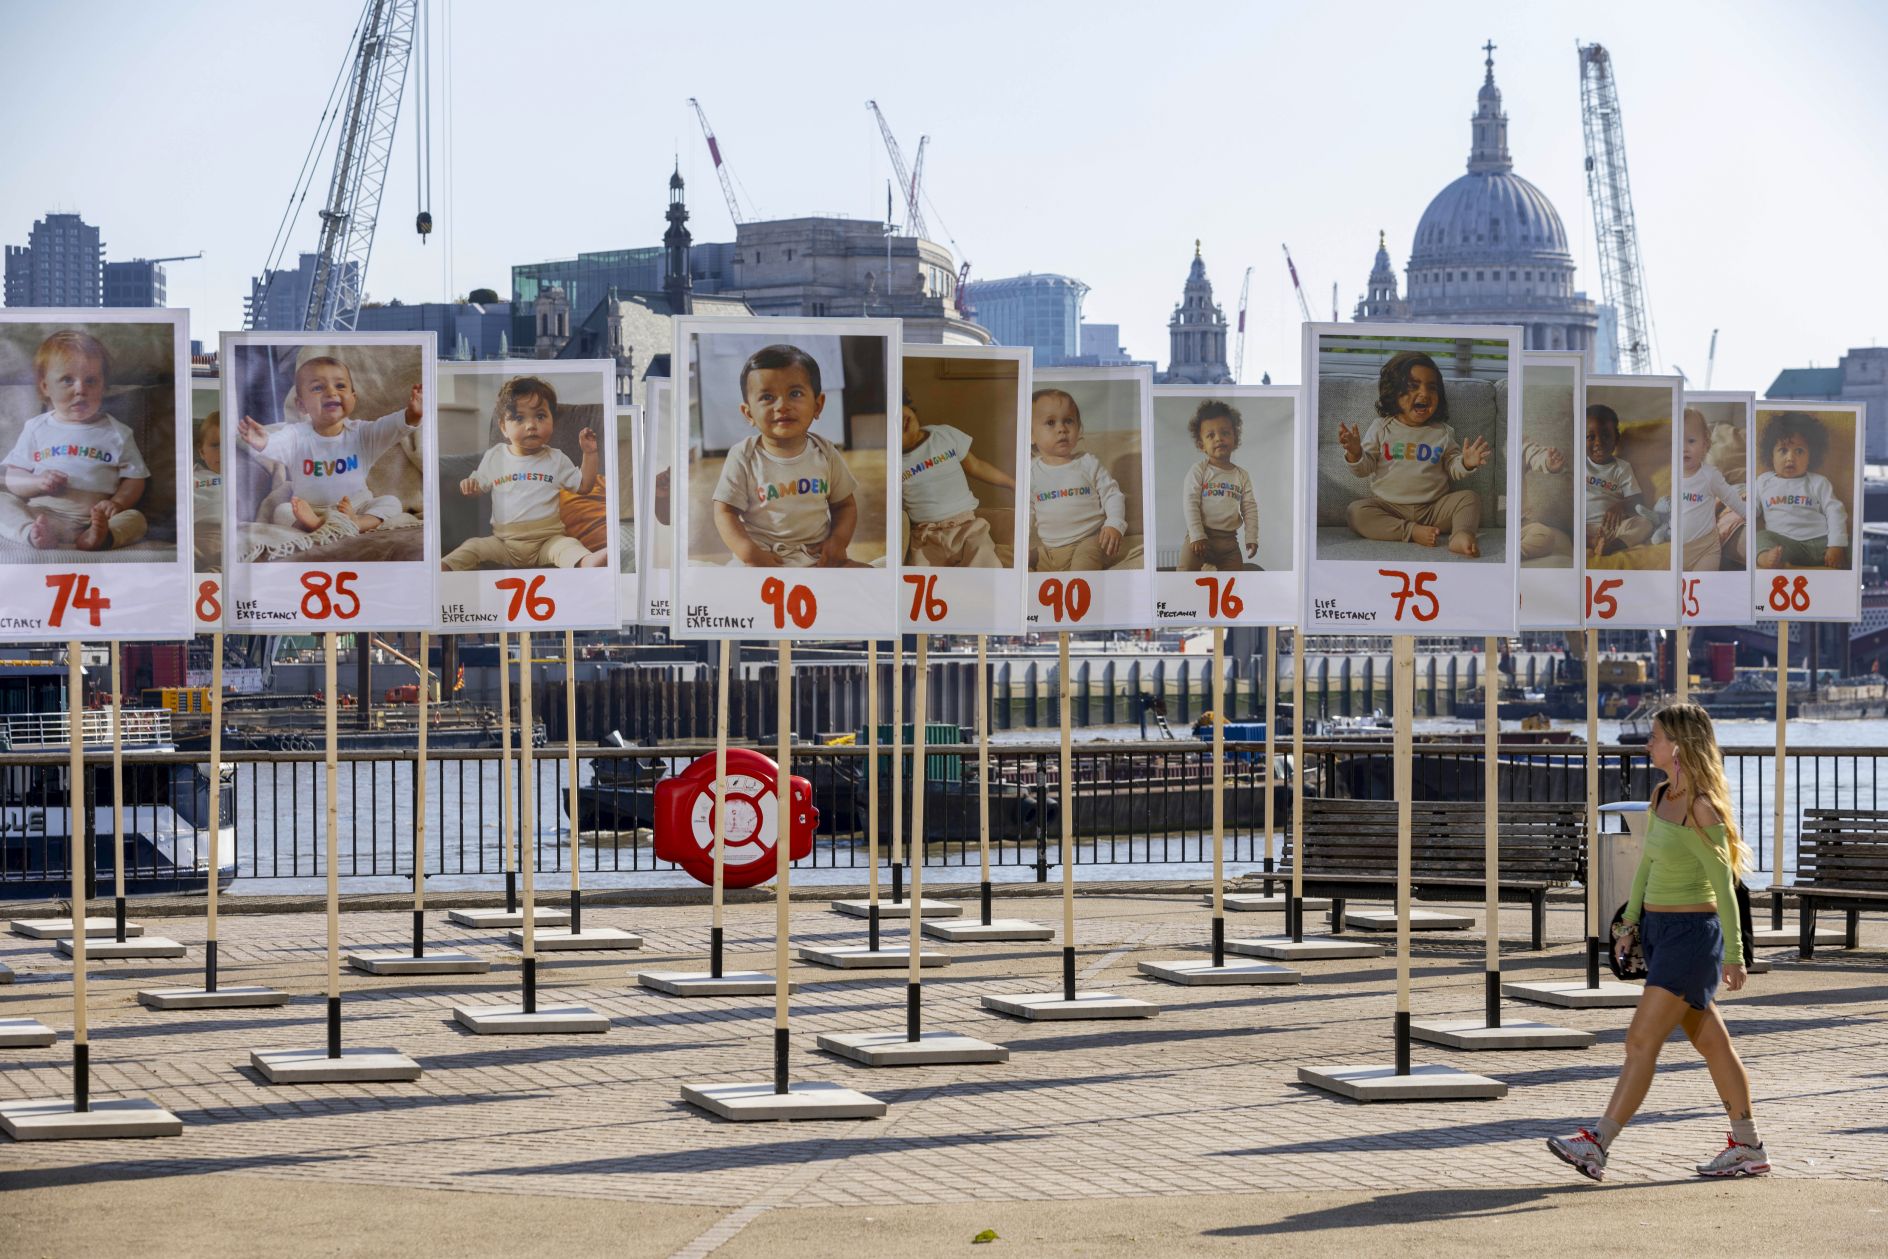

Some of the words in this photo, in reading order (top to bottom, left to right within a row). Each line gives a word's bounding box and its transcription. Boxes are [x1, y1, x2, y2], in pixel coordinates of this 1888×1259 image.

[34, 444, 112, 463] BIRKENHEAD
[1382, 442, 1443, 464] LEEDS
[303, 454, 358, 477] DEVON
[494, 472, 554, 487] MANCHESTER
[756, 478, 828, 502] CAMDEN
[1036, 486, 1091, 502] KENSINGTON
[1765, 495, 1813, 508] LAMBETH
[46, 573, 110, 627] 74
[301, 571, 360, 619] 85
[495, 575, 556, 622] 76
[761, 576, 817, 629] 90
[903, 575, 948, 622] 76
[1038, 578, 1091, 622] 90
[1196, 577, 1243, 618] 76
[1379, 570, 1439, 621] 75
[1769, 576, 1810, 611] 88
[237, 600, 257, 609] LIFE
[237, 609, 297, 620] EXPECTANCY
[442, 605, 464, 613] LIFE
[687, 605, 708, 616] LIFE
[1315, 599, 1336, 610] LIFE
[442, 613, 498, 623] EXPECTANCY
[687, 616, 754, 628] EXPECTANCY
[1315, 609, 1376, 621] EXPECTANCY
